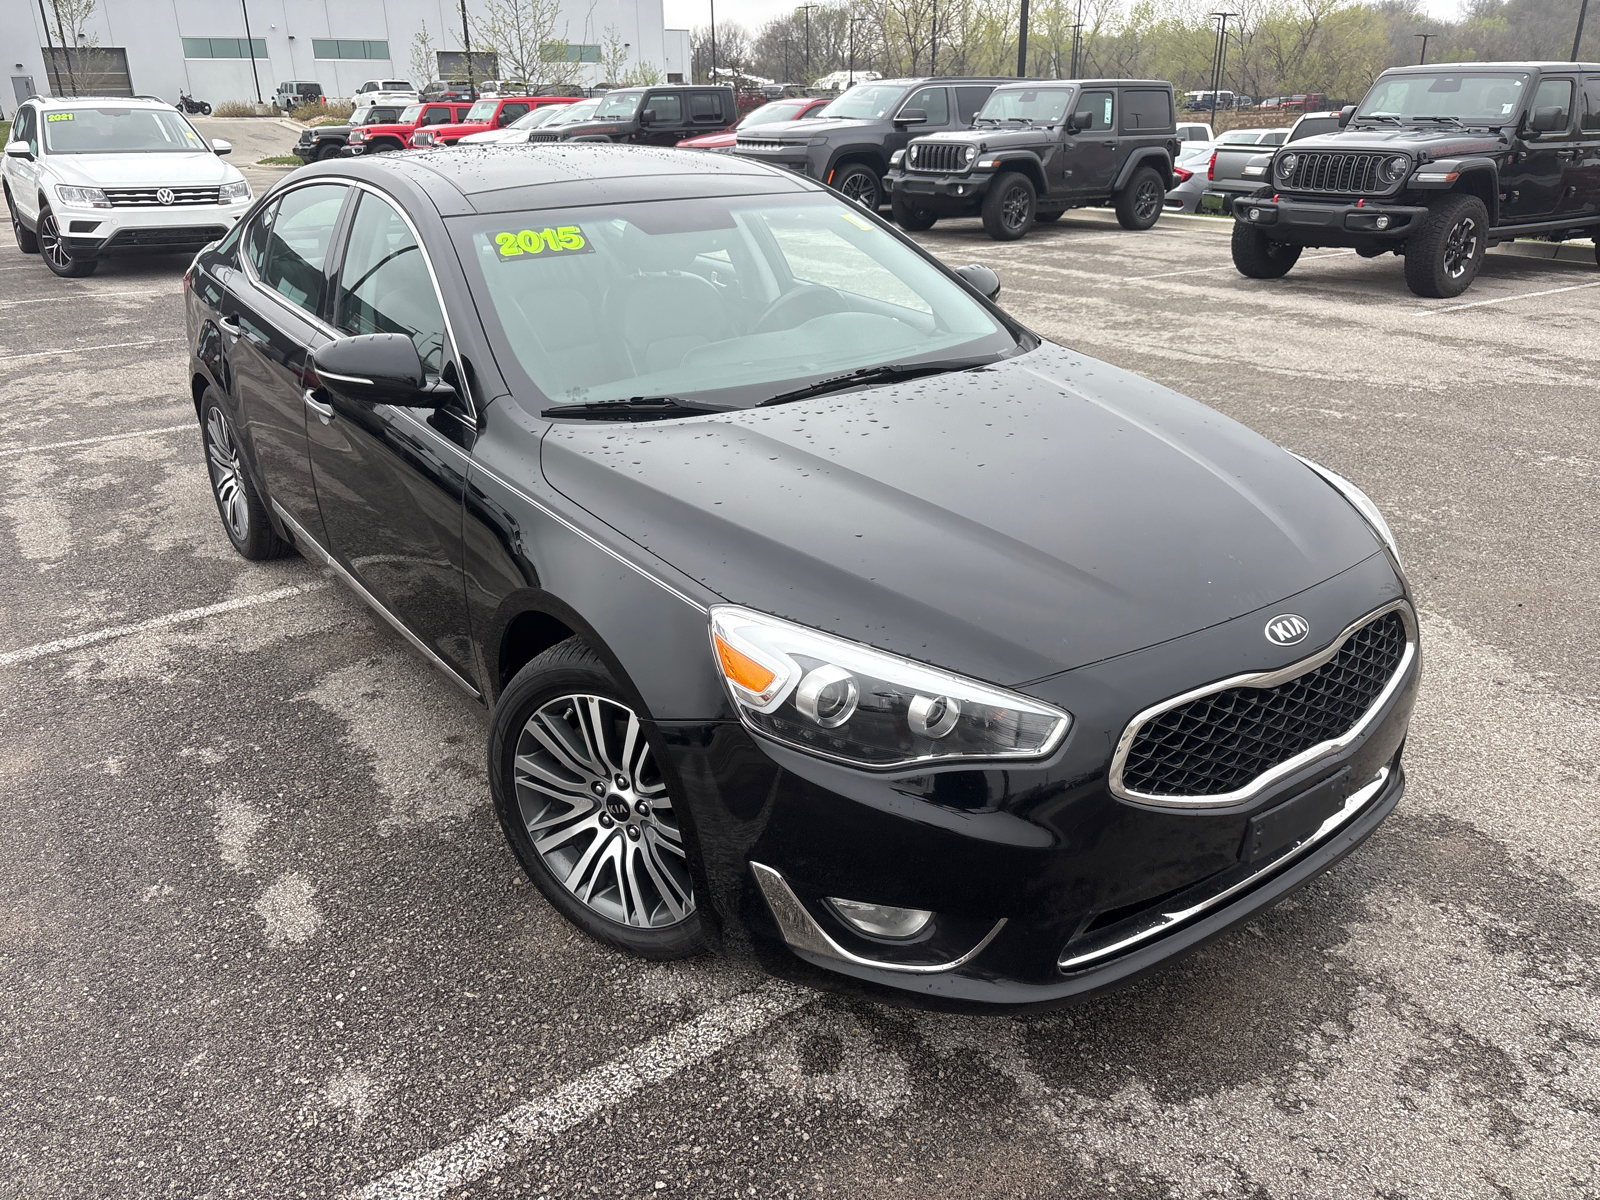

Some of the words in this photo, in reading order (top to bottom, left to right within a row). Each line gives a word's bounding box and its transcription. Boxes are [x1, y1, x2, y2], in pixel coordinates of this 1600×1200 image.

[495, 226, 585, 256] 2015
[1270, 617, 1307, 641] KIA
[608, 804, 627, 814] KIA
